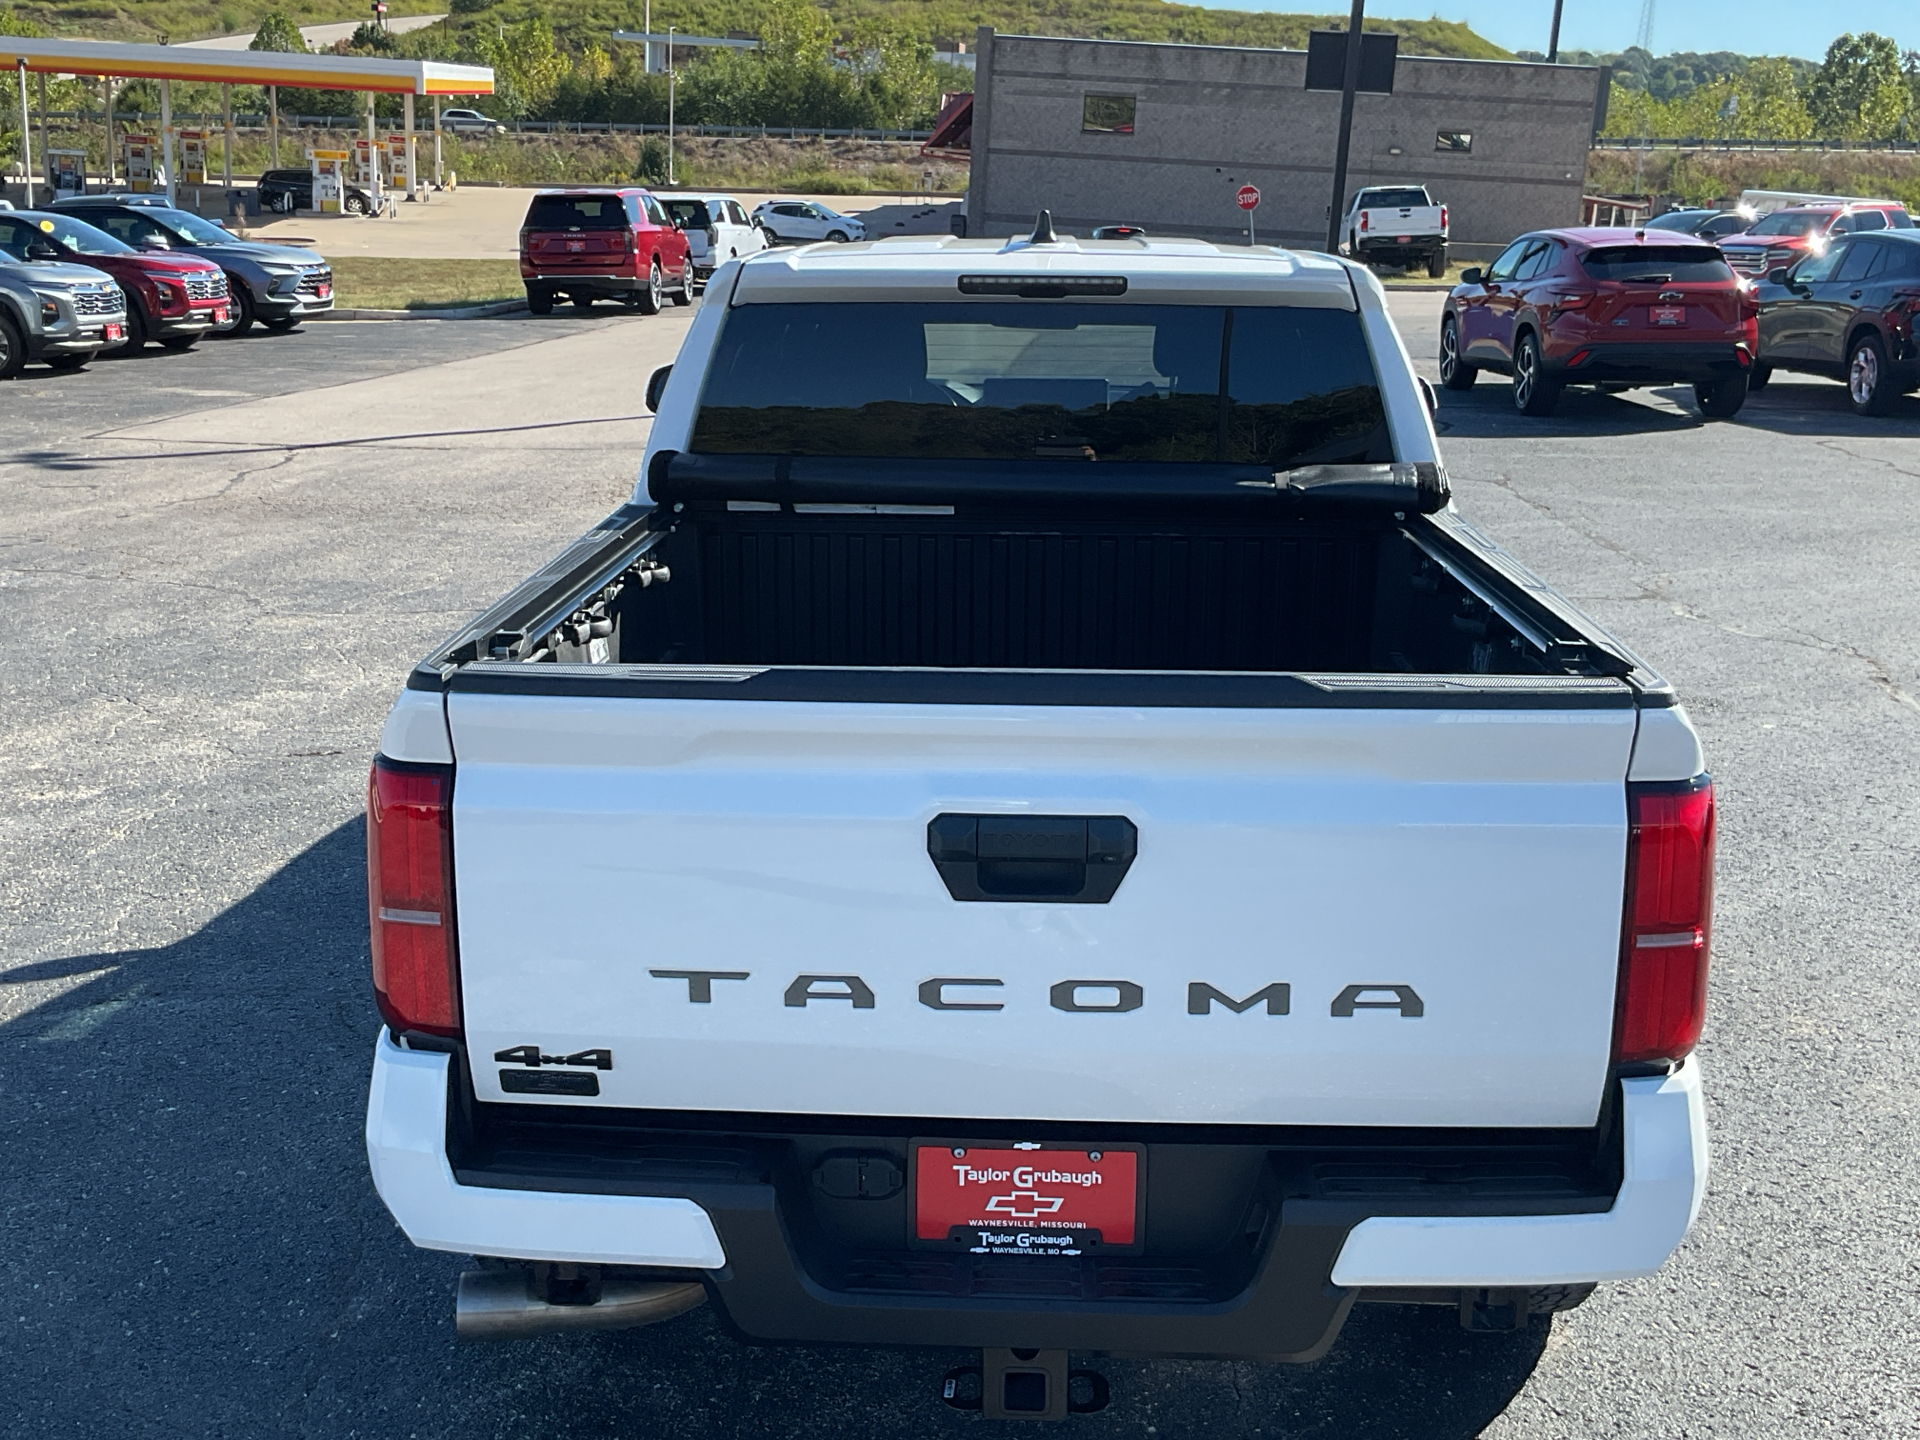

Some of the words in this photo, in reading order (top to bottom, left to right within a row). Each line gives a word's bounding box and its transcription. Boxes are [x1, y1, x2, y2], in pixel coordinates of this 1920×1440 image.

[1238, 193, 1258, 204] STOP
[984, 833, 1081, 849] TOYOTA
[648, 970, 1425, 1018] TACOMA
[952, 1165, 1010, 1186] Taylor
[1012, 1166, 1102, 1188] Grubaugh
[968, 1219, 1038, 1229] WAYNESVILLE,
[1040, 1221, 1087, 1230] MISSOURI
[977, 1232, 1015, 1246] Taylor
[1016, 1233, 1073, 1247] Grubaugh
[992, 1246, 1046, 1255] WAYNESVILLE,
